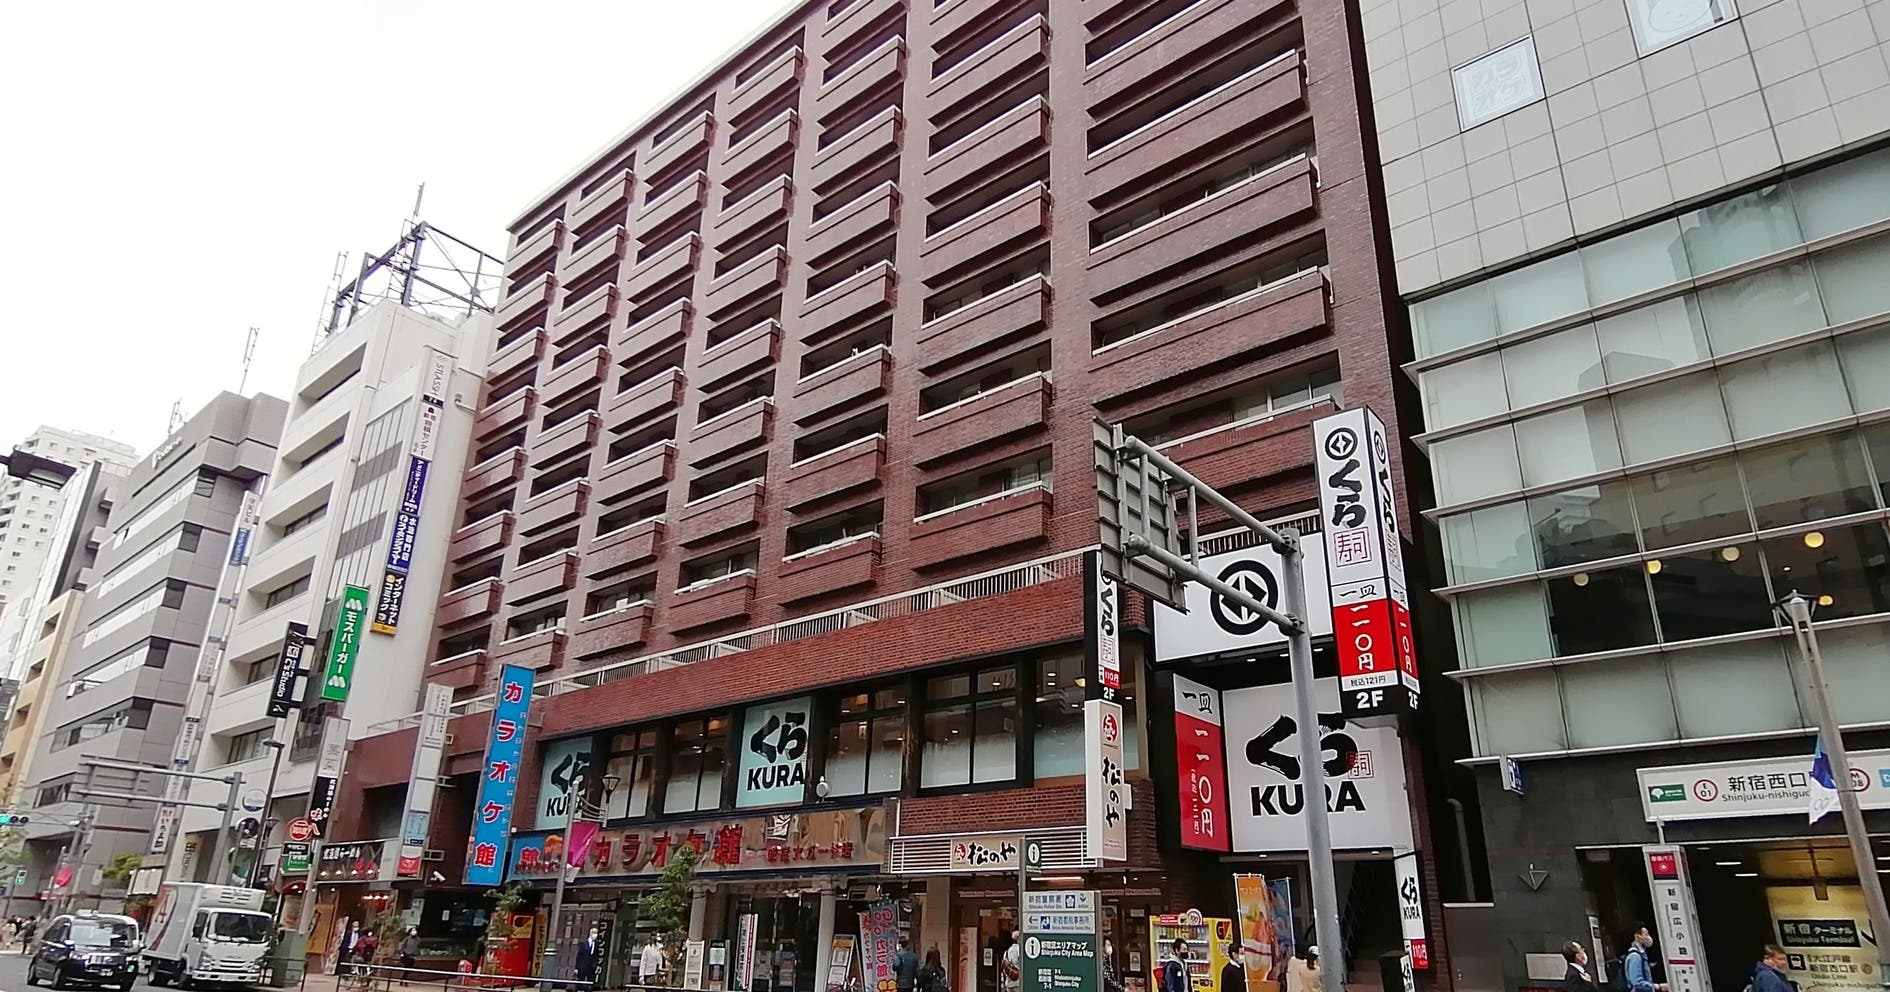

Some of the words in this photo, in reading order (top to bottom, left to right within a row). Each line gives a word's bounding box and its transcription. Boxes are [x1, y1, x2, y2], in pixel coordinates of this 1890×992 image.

[379, 583, 393, 611] コミック
[388, 577, 404, 625] インターネット
[1339, 584, 1376, 599] 一皿
[338, 610, 358, 674] モスバーガー
[1103, 686, 1116, 700] 2F
[1351, 675, 1386, 687] 税込121円
[1181, 690, 1212, 715] 一皿
[1356, 690, 1384, 709] 2F
[1408, 690, 1418, 710] 2F
[750, 711, 808, 763] くら
[475, 682, 523, 867] カラオケ館
[747, 762, 806, 791] KURA
[1728, 770, 1813, 793] 新宿西口
[1102, 756, 1121, 829] 松のや
[1700, 789, 1712, 798] 01
[1721, 788, 1811, 804] Shinjuku-nishiguc
[594, 823, 743, 868] カラオケ館
[967, 841, 1016, 866] 松のや
[1401, 876, 1419, 906] くら
[1402, 907, 1422, 921] KURA
